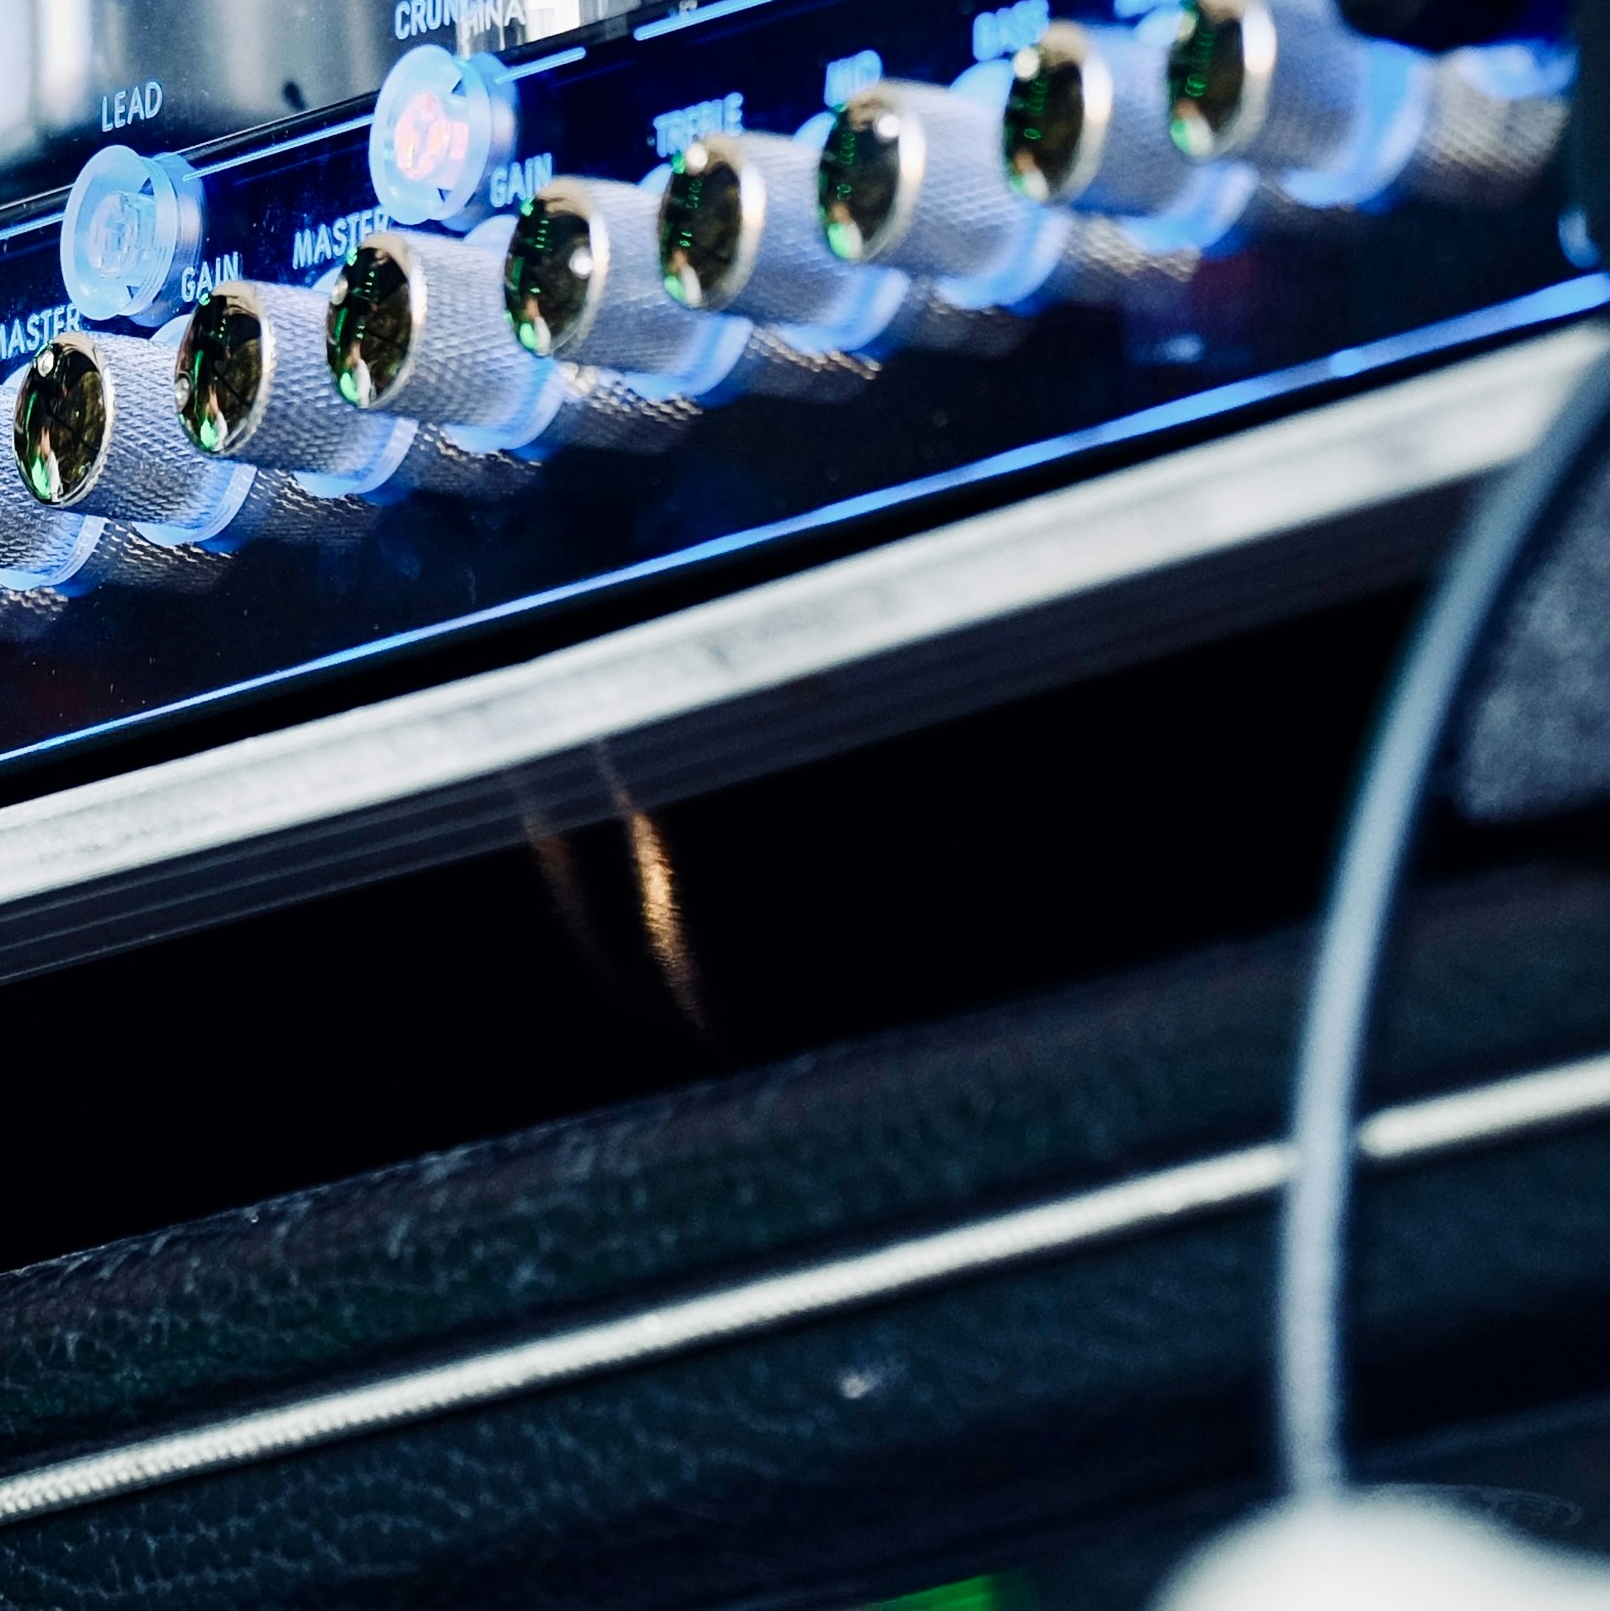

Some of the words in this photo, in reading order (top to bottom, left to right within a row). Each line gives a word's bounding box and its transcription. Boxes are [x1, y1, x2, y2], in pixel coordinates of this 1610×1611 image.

[101, 81, 163, 132] LEAD
[490, 152, 553, 208] GAIN
[293, 205, 391, 269] MASTER
[181, 251, 239, 302] GAIN
